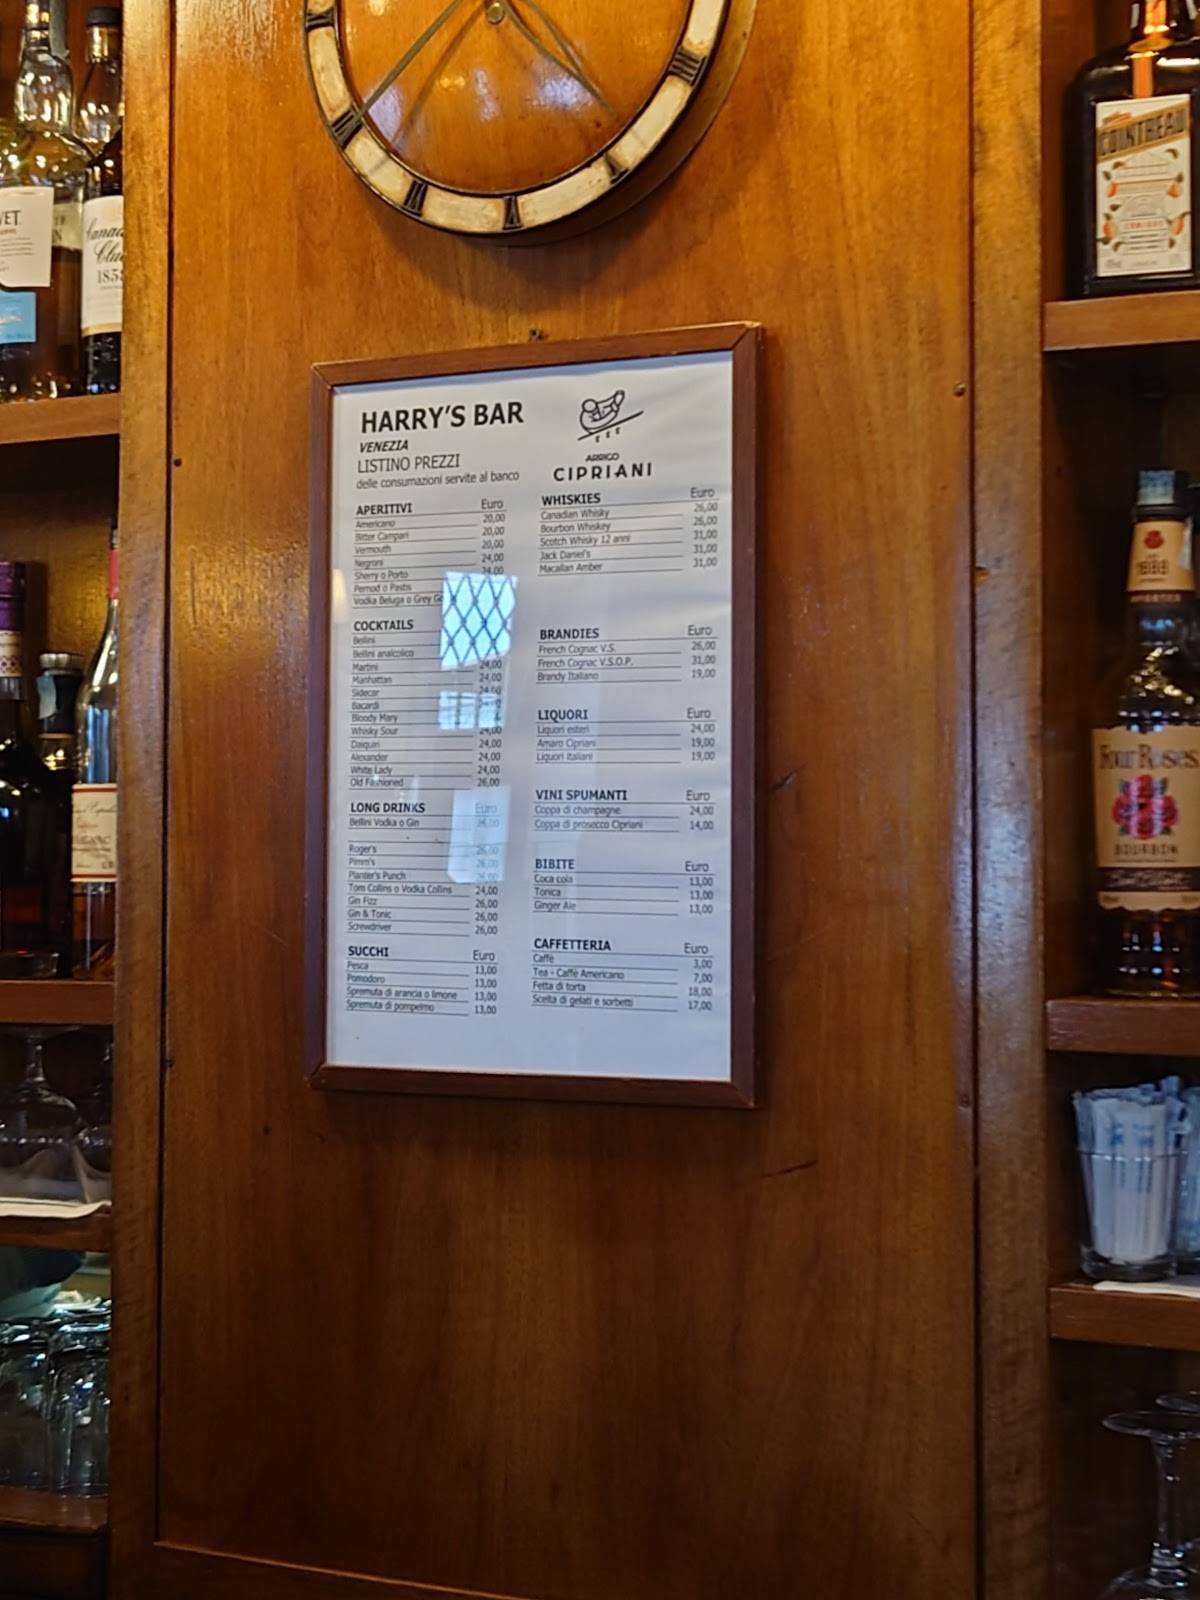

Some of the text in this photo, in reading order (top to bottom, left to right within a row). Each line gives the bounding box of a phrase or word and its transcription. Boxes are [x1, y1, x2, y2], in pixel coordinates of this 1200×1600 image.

[361, 401, 524, 433] HARRY'S BAR
[360, 440, 409, 453] VENEZIA
[358, 453, 460, 473] LISTINO PREZZI
[553, 462, 652, 481] CIPRIANI
[356, 478, 378, 489] delle
[381, 475, 442, 487] consumazioni
[445, 473, 476, 485] servite
[491, 471, 519, 481] banco
[541, 487, 715, 506] WHISKIES Euro
[356, 499, 503, 515] APERITIVI Euro
[541, 509, 610, 519] Canadian Whisky
[356, 514, 505, 528] Americano 20,00
[378, 532, 409, 542] Campari
[482, 527, 504, 536] 20,00
[540, 524, 575, 533] Bourbon
[540, 538, 567, 546] Scotch
[570, 536, 598, 546] Whisky
[694, 530, 717, 540] 31,00
[355, 540, 504, 554] Vermouth 20,00
[540, 544, 717, 561] Jack 31,00
[482, 553, 504, 563] 24,00
[576, 558, 717, 571] Amber 31,00
[354, 620, 414, 631] COCKTAILS
[540, 625, 712, 640] BRANDIES Euro
[353, 636, 375, 644] Bellini
[539, 645, 566, 653] French
[692, 641, 716, 651] 26,00
[353, 663, 378, 671] Martini
[538, 659, 565, 668] French
[692, 656, 716, 665] 31,00
[352, 673, 501, 684] Manhattan 24,00
[537, 669, 716, 682] Brandy Italiano 19,00
[379, 714, 398, 723] Mary
[538, 708, 711, 722] LIQUORI Euro
[691, 724, 715, 734] 24,00
[480, 739, 501, 749] 24,00
[691, 738, 715, 748] 19,00
[351, 752, 500, 762] Alexander 24,00
[691, 752, 715, 762] 19,00
[351, 765, 500, 775] White Lady 24,00
[536, 790, 710, 801] VINI SPUMANTI Euro
[351, 803, 497, 814] LONG DRINKS Euro
[535, 805, 560, 816] Coppa
[690, 806, 714, 816] 24,00
[350, 818, 419, 827] Bellini Vodka Gin
[535, 820, 560, 830] Coppa
[690, 821, 714, 831] 14,00
[349, 844, 376, 855] Roger's
[349, 858, 375, 866] Pimm's
[535, 859, 709, 872] BIBITE Euro
[383, 871, 406, 880] Punch
[534, 875, 713, 887] Coca 13,00
[349, 884, 498, 896] Tom Collins Vodka Collins 24,00
[534, 888, 713, 901] Tonica 13,00
[348, 896, 498, 909] Gin Fizz 26,00
[534, 901, 713, 914] Ginger 13,00
[347, 910, 498, 922] Gin Tonic 26,00
[475, 926, 498, 936] 26,00
[534, 938, 708, 954] CAFFETTERIA Euro
[348, 946, 495, 961] SUCCHI Euro
[347, 961, 497, 975] Pesca 13,00
[694, 960, 712, 970] 3,00
[347, 974, 496, 988] Pomodoro 13,00
[533, 968, 712, 984] Tea Americano 7,00
[347, 987, 496, 1002] Spremuta limone 13,00
[533, 981, 712, 997] Fetta torta 18,00
[347, 1000, 496, 1014] Spremuta 13,00
[688, 1001, 712, 1011] 17,00
